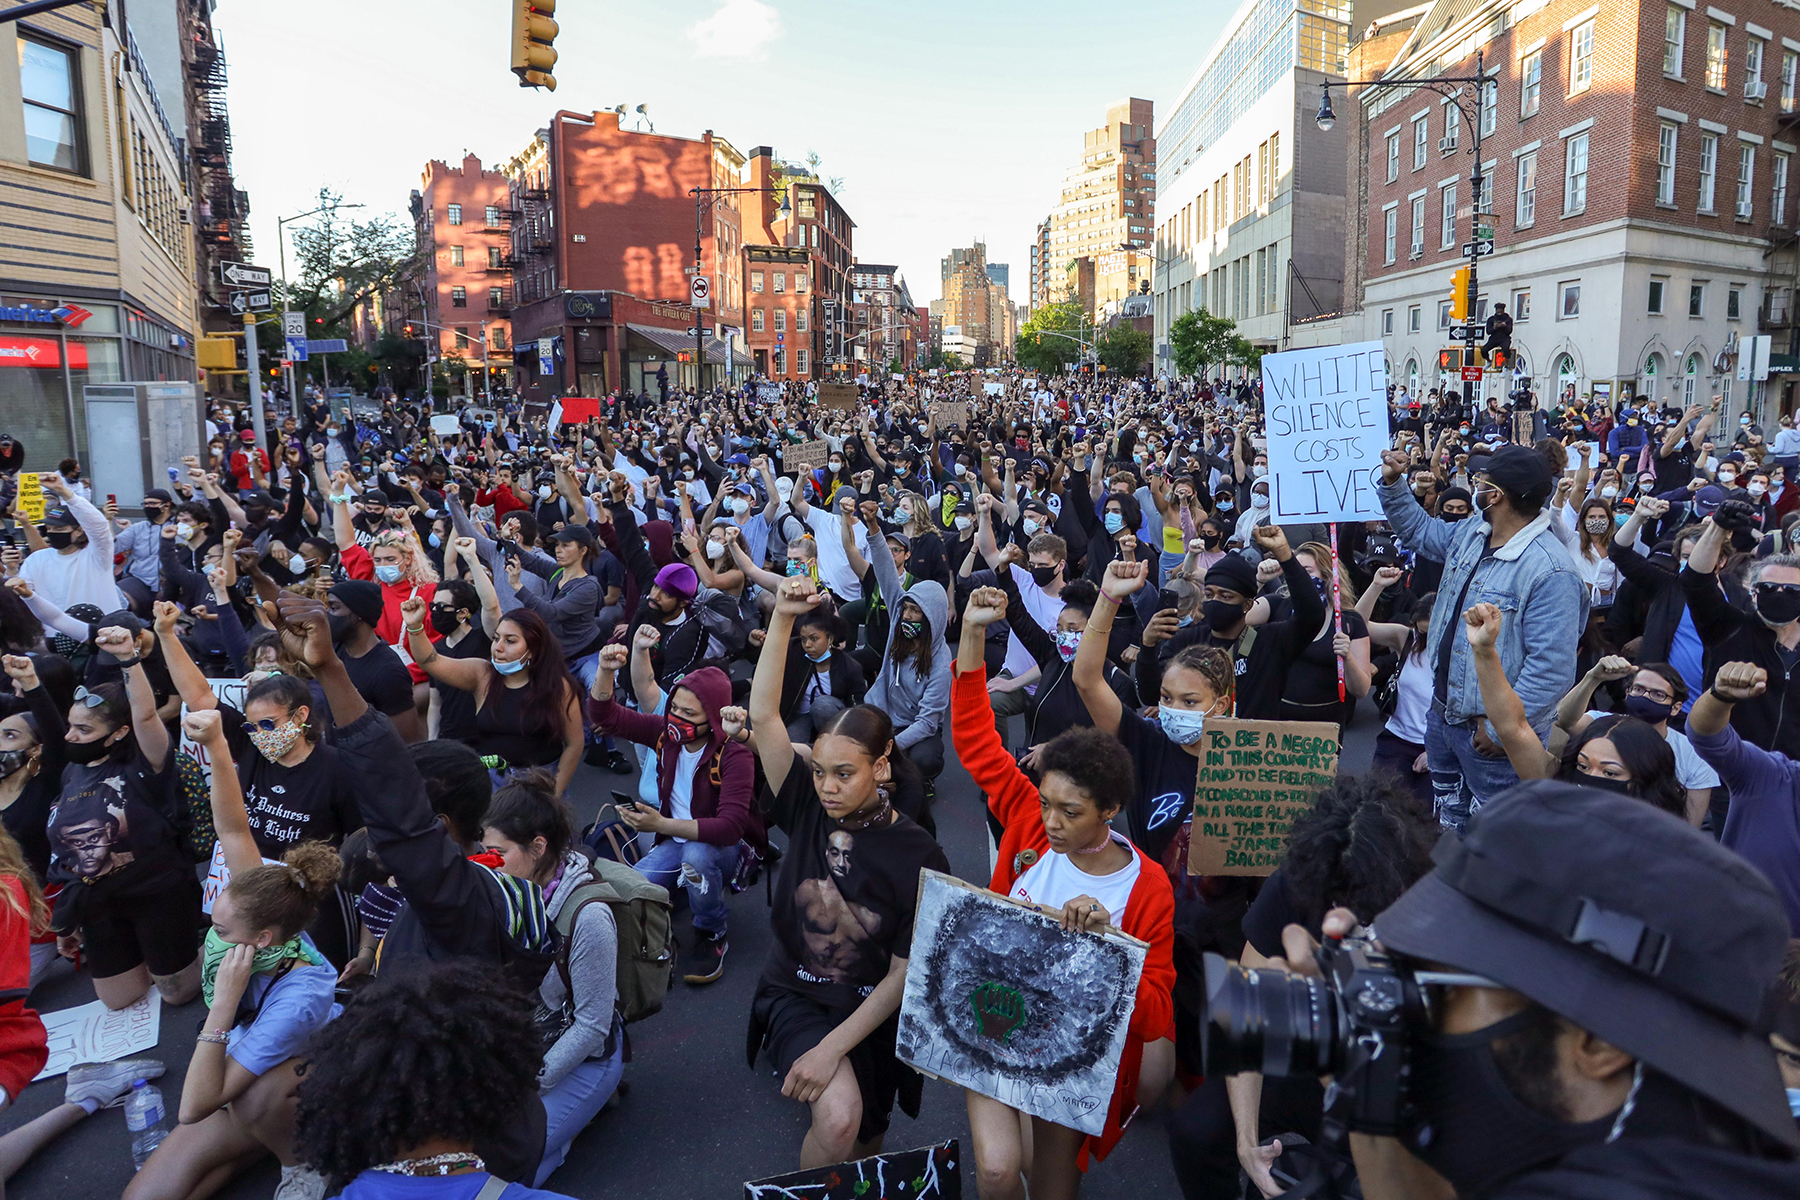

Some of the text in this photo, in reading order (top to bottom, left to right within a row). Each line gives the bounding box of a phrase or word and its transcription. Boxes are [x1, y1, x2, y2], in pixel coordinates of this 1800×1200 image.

[1098, 252, 1127, 266] MAGIC
[230, 269, 266, 280] ONE WAY
[236, 295, 266, 306] ON WAY
[0, 306, 53, 322] merica
[288, 324, 303, 334] 20
[1265, 350, 1384, 400] WHITE
[938, 404, 961, 412] BLACK
[1272, 398, 1376, 436] SILENCE
[1294, 436, 1364, 462] COSTS
[1206, 730, 1231, 749] TO
[1235, 730, 1260, 747] BE
[1266, 732, 1277, 748] A
[1282, 734, 1336, 755] NEGRO
[1206, 749, 1334, 770] IN THIS COUNTRY
[1200, 767, 1235, 783] AND
[1235, 769, 1256, 782] TO
[1258, 769, 1278, 783] BE
[1206, 787, 1272, 802] CONSCIOUS
[1274, 789, 1288, 802] IS
[1290, 790, 1308, 802] TO
[253, 796, 310, 822] Darkness
[1196, 804, 1311, 820] IN A RAGE ALMO
[264, 819, 301, 843] Light
[1203, 823, 1230, 837] ALL
[1232, 822, 1265, 836] THE
[912, 1036, 985, 1087] BLACK
[994, 1073, 1056, 1109] LIVES
[1062, 1096, 1096, 1110] MATTER
